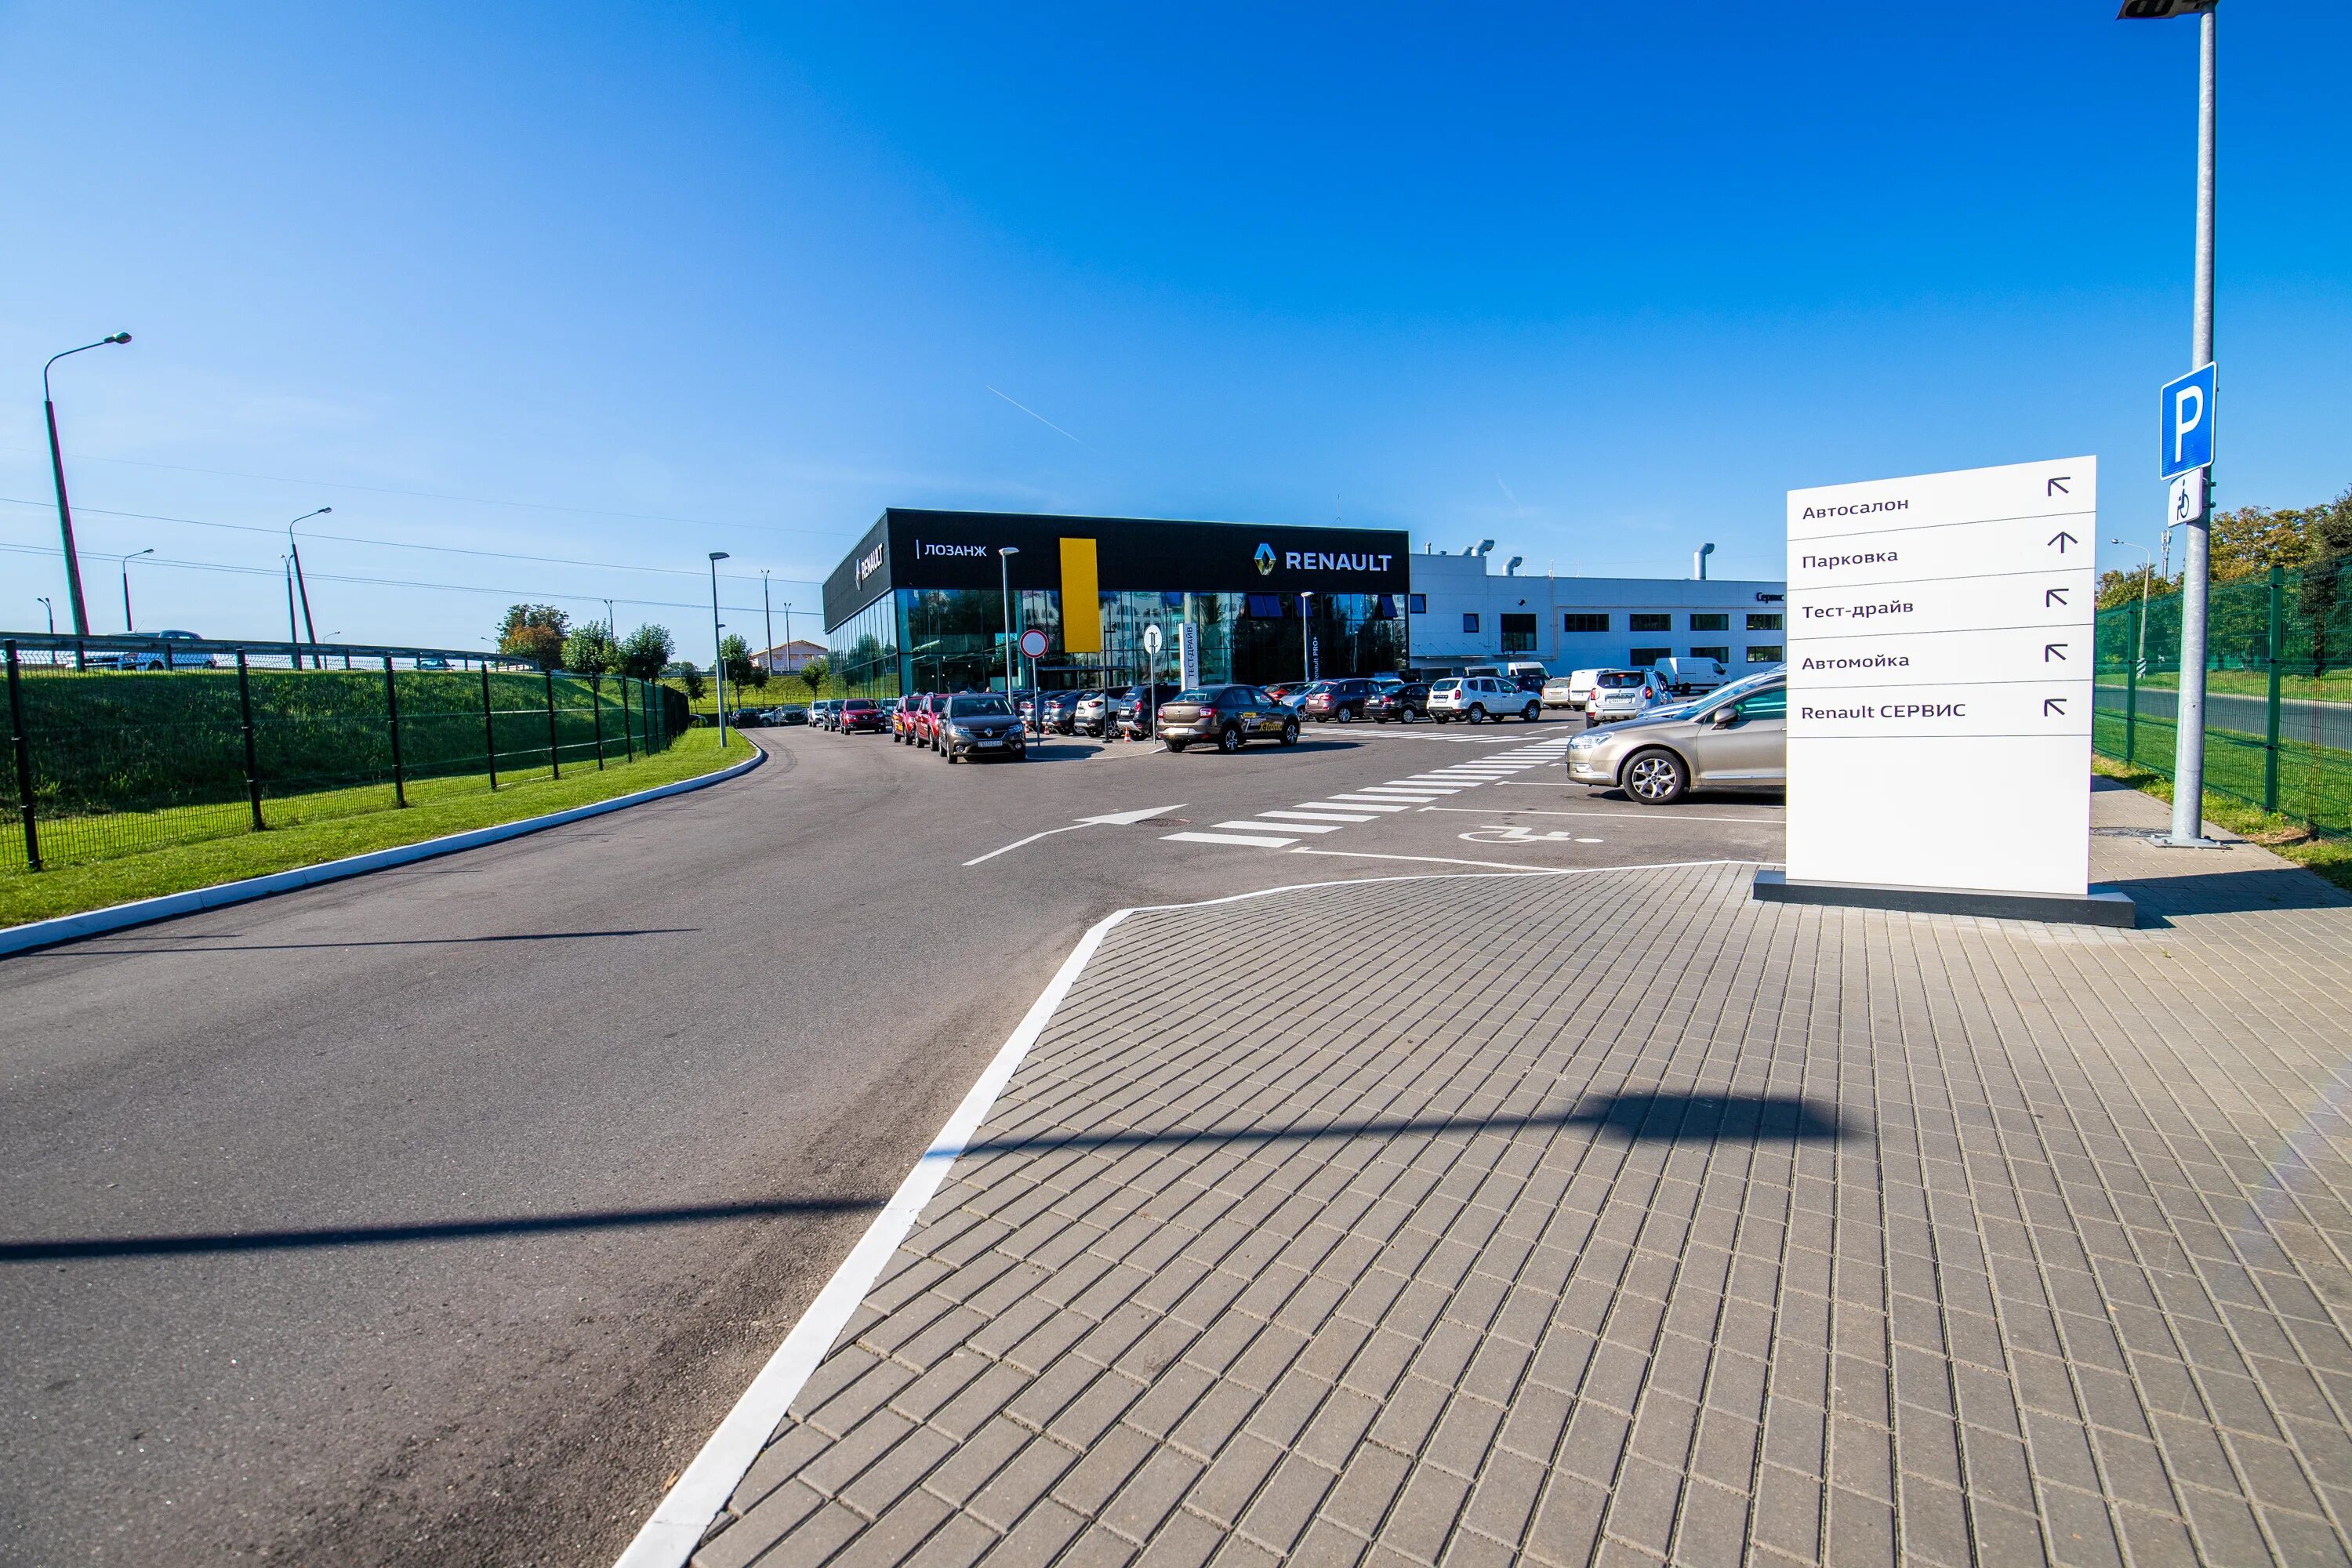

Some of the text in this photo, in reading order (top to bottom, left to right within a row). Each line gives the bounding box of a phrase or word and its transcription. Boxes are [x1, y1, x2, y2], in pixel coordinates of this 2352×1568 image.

[2175, 385, 2204, 463] P
[1802, 499, 1909, 520] Автосалон
[924, 544, 987, 557] ЛОЗАНЖ
[1802, 550, 1899, 570] Парковка
[861, 543, 884, 580] RENAULT
[1285, 551, 1392, 572] RENAULT
[1802, 600, 1915, 619] Тест-драйв
[1185, 626, 1195, 678] ТЕСТ-ДРАЙВ
[1802, 653, 1911, 670] Автомойка
[1802, 702, 1966, 720] Renault СЕРВИС
